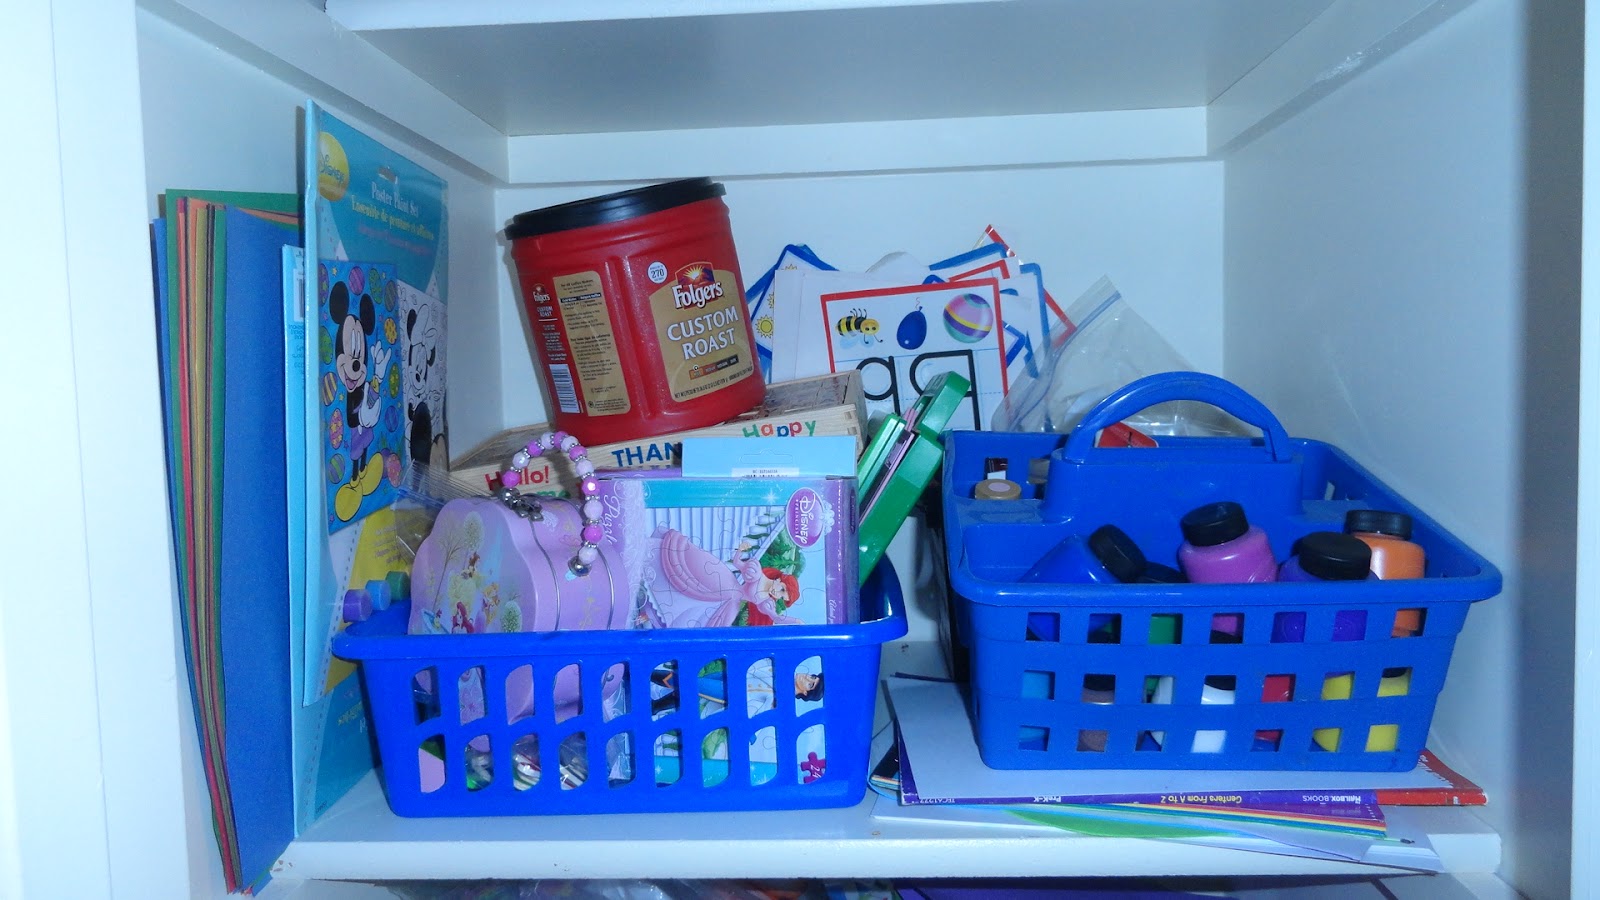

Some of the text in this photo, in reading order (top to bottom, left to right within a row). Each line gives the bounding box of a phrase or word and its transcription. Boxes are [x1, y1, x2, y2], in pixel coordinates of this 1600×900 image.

[651, 268, 664, 279] 270
[671, 281, 724, 310] Folgers
[666, 305, 739, 341] CUSTOM
[682, 327, 735, 361] ROAST
[742, 420, 816, 437] Happy
[484, 465, 549, 491] Hllo!
[794, 493, 816, 544] Disney
[1160, 795, 1242, 804] Centers From A to Z
[1331, 795, 1361, 803] MAILBOX
